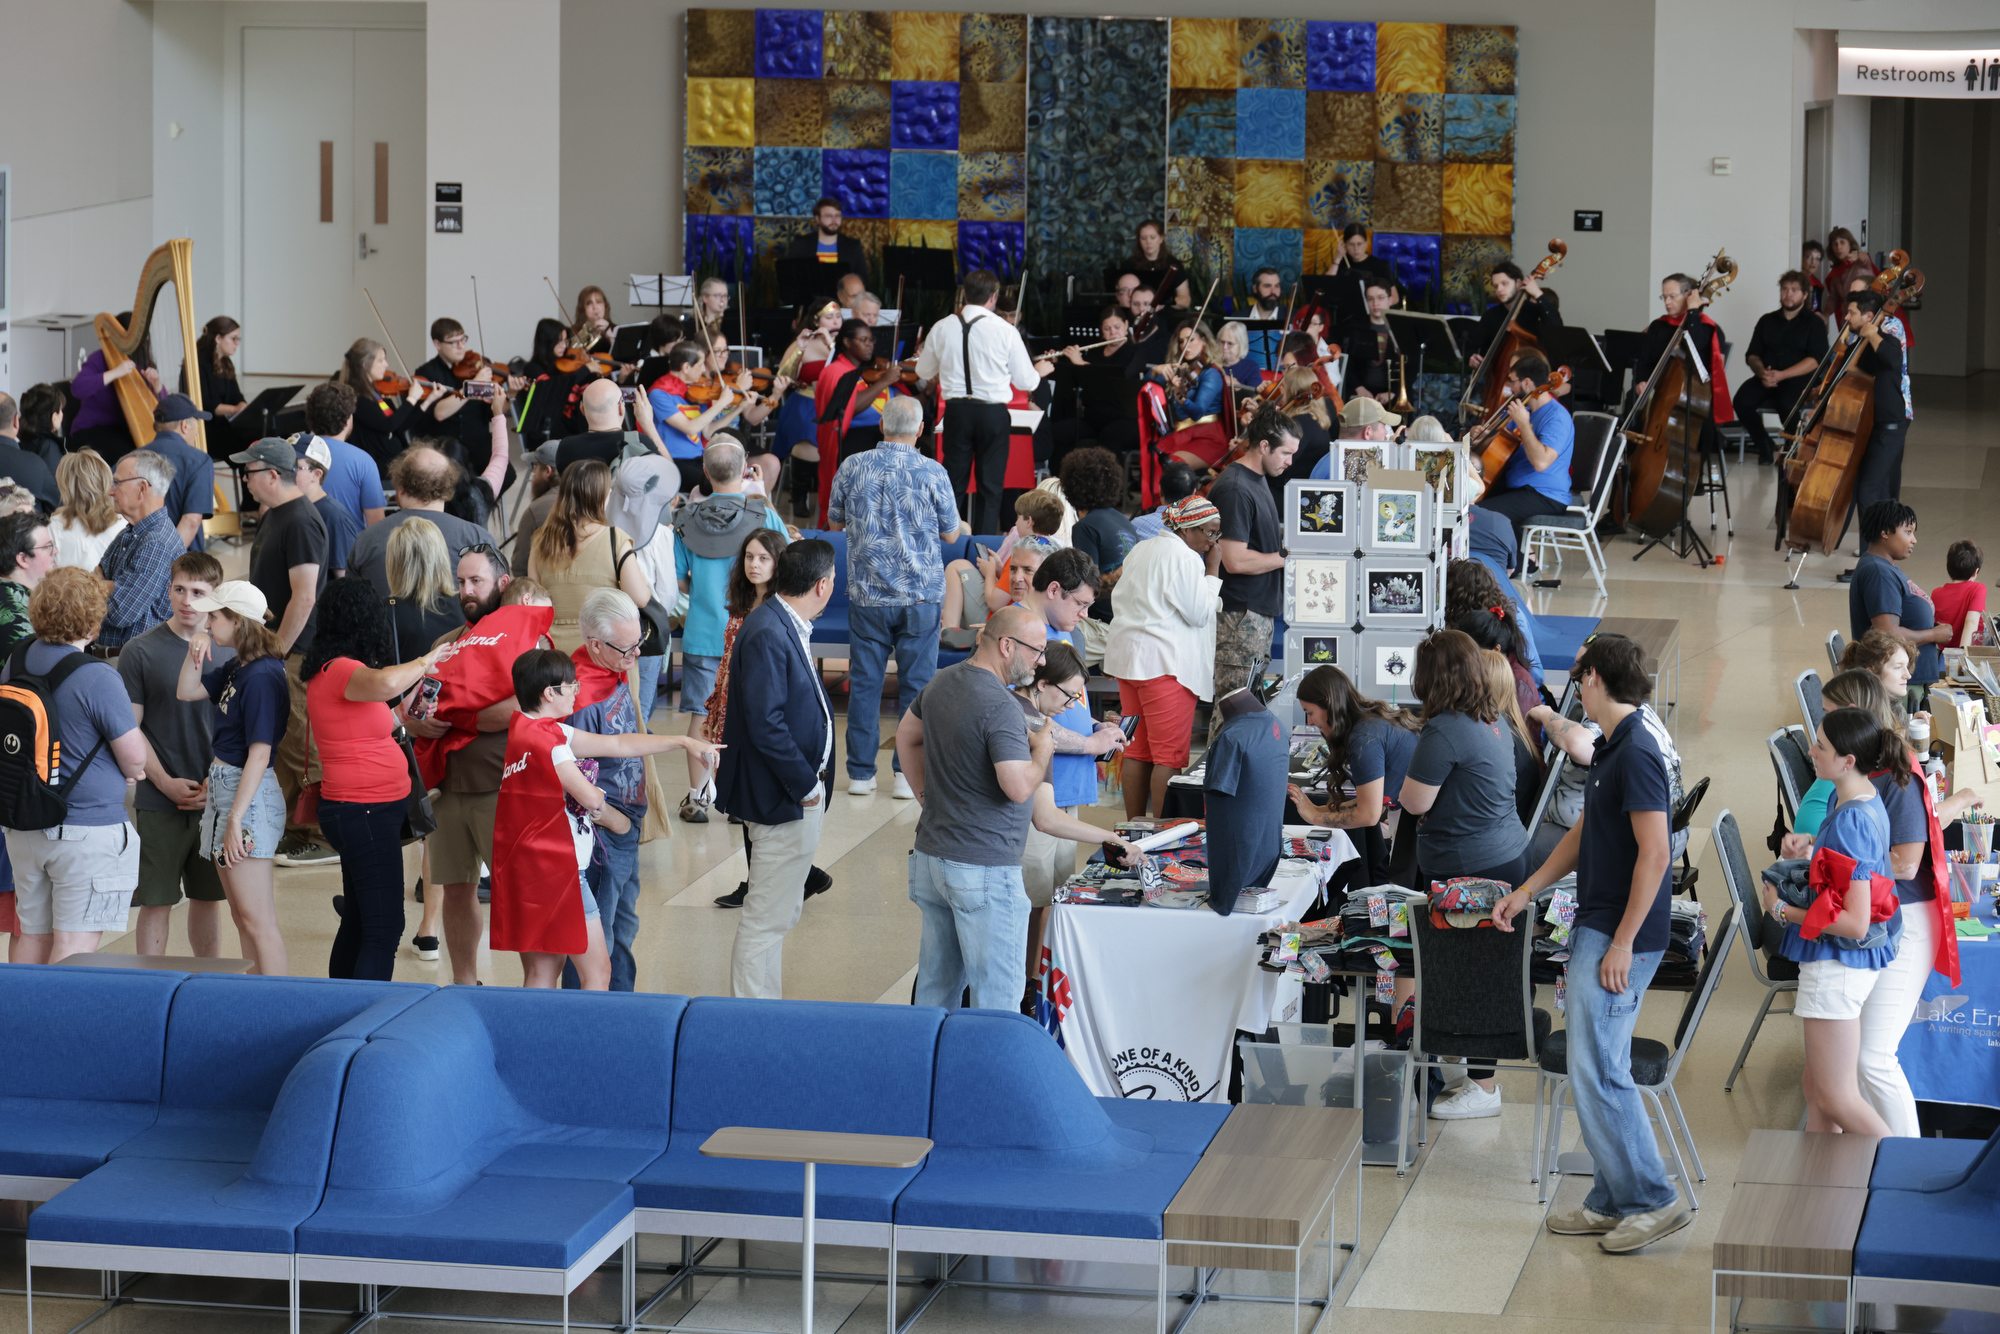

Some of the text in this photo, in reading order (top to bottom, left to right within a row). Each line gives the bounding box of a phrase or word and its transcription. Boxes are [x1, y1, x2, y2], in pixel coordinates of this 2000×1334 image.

[1857, 65, 1956, 82] Restrooms
[1915, 1000, 1965, 1023] Lake
[1928, 1023, 1936, 1032] A
[1938, 1024, 1971, 1036] writing
[1140, 1046, 1160, 1060] OF
[1161, 1052, 1172, 1065] A
[1173, 1057, 1200, 1092] KIND
